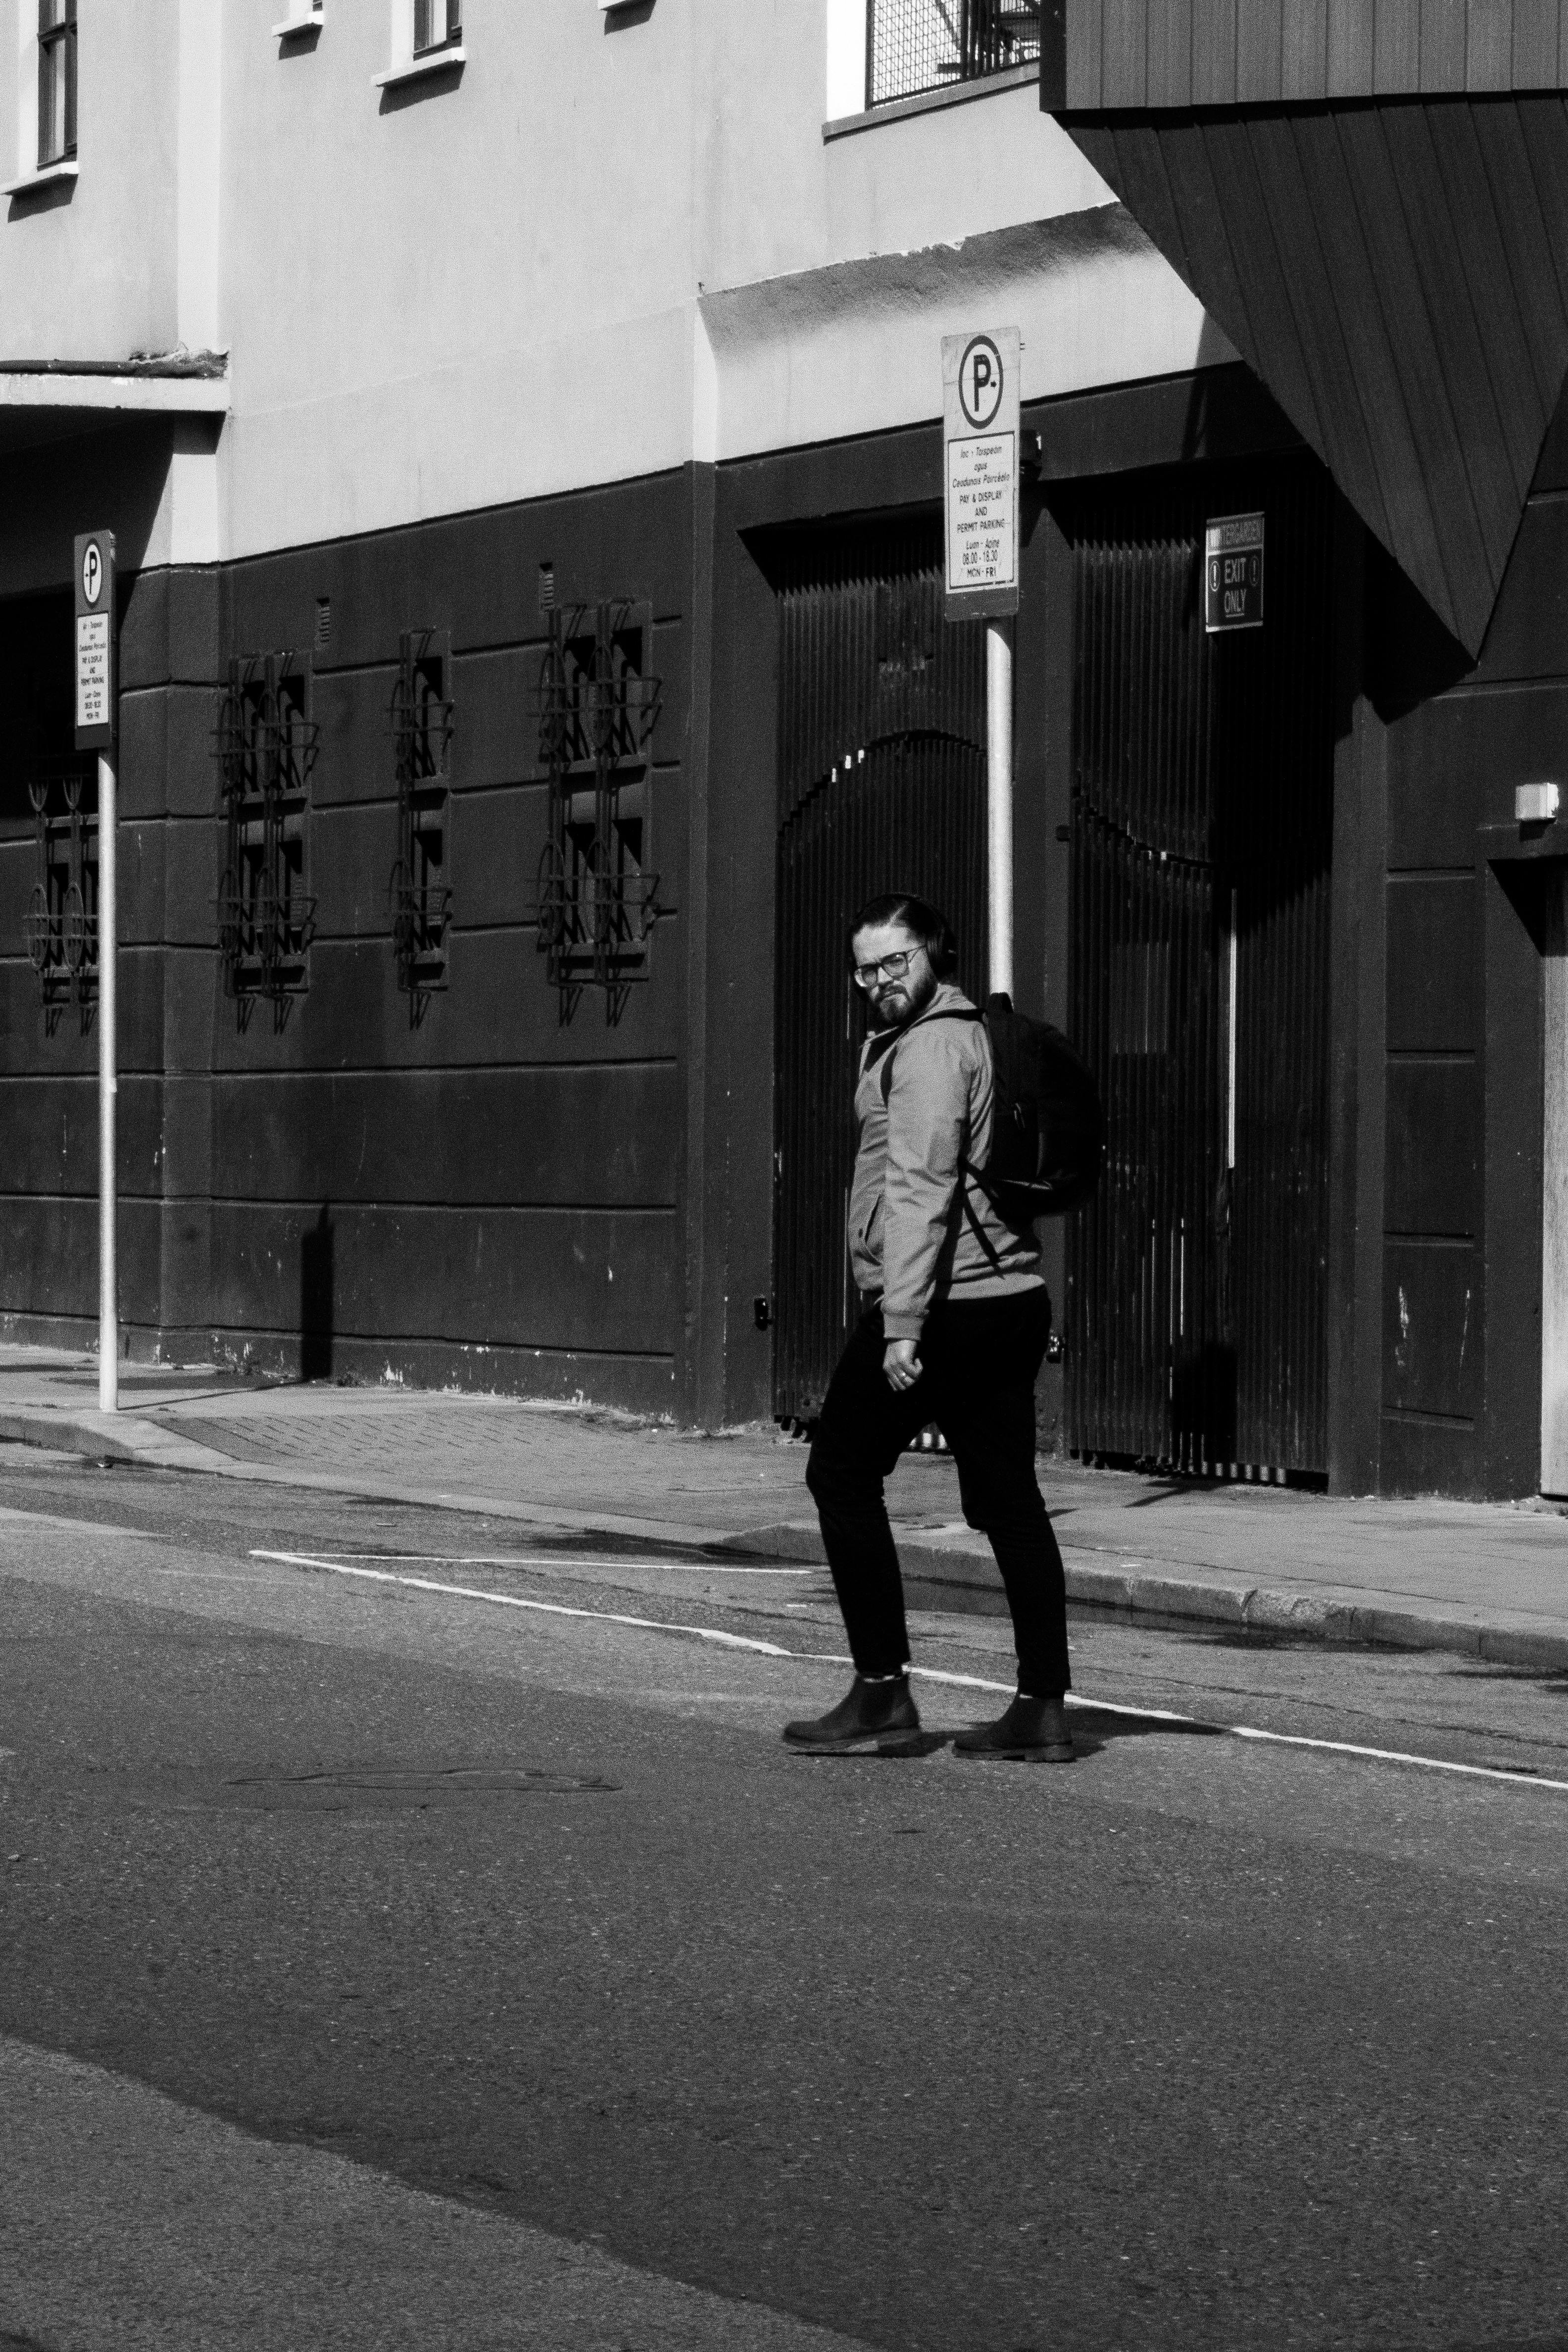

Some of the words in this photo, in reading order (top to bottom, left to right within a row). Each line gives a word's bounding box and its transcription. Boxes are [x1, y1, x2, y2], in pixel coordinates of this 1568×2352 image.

[974, 354, 991, 412] P
[959, 495, 970, 504] PAY
[978, 490, 1002, 502] DISPLAY
[975, 506, 987, 516] AND
[957, 522, 978, 533] PERMIT
[980, 518, 1005, 530] PARKING
[89, 551, 98, 594] P
[967, 568, 981, 578] MON
[985, 566, 996, 578] FRI
[1225, 558, 1246, 584] EXIT
[1224, 589, 1246, 614] ONLY
